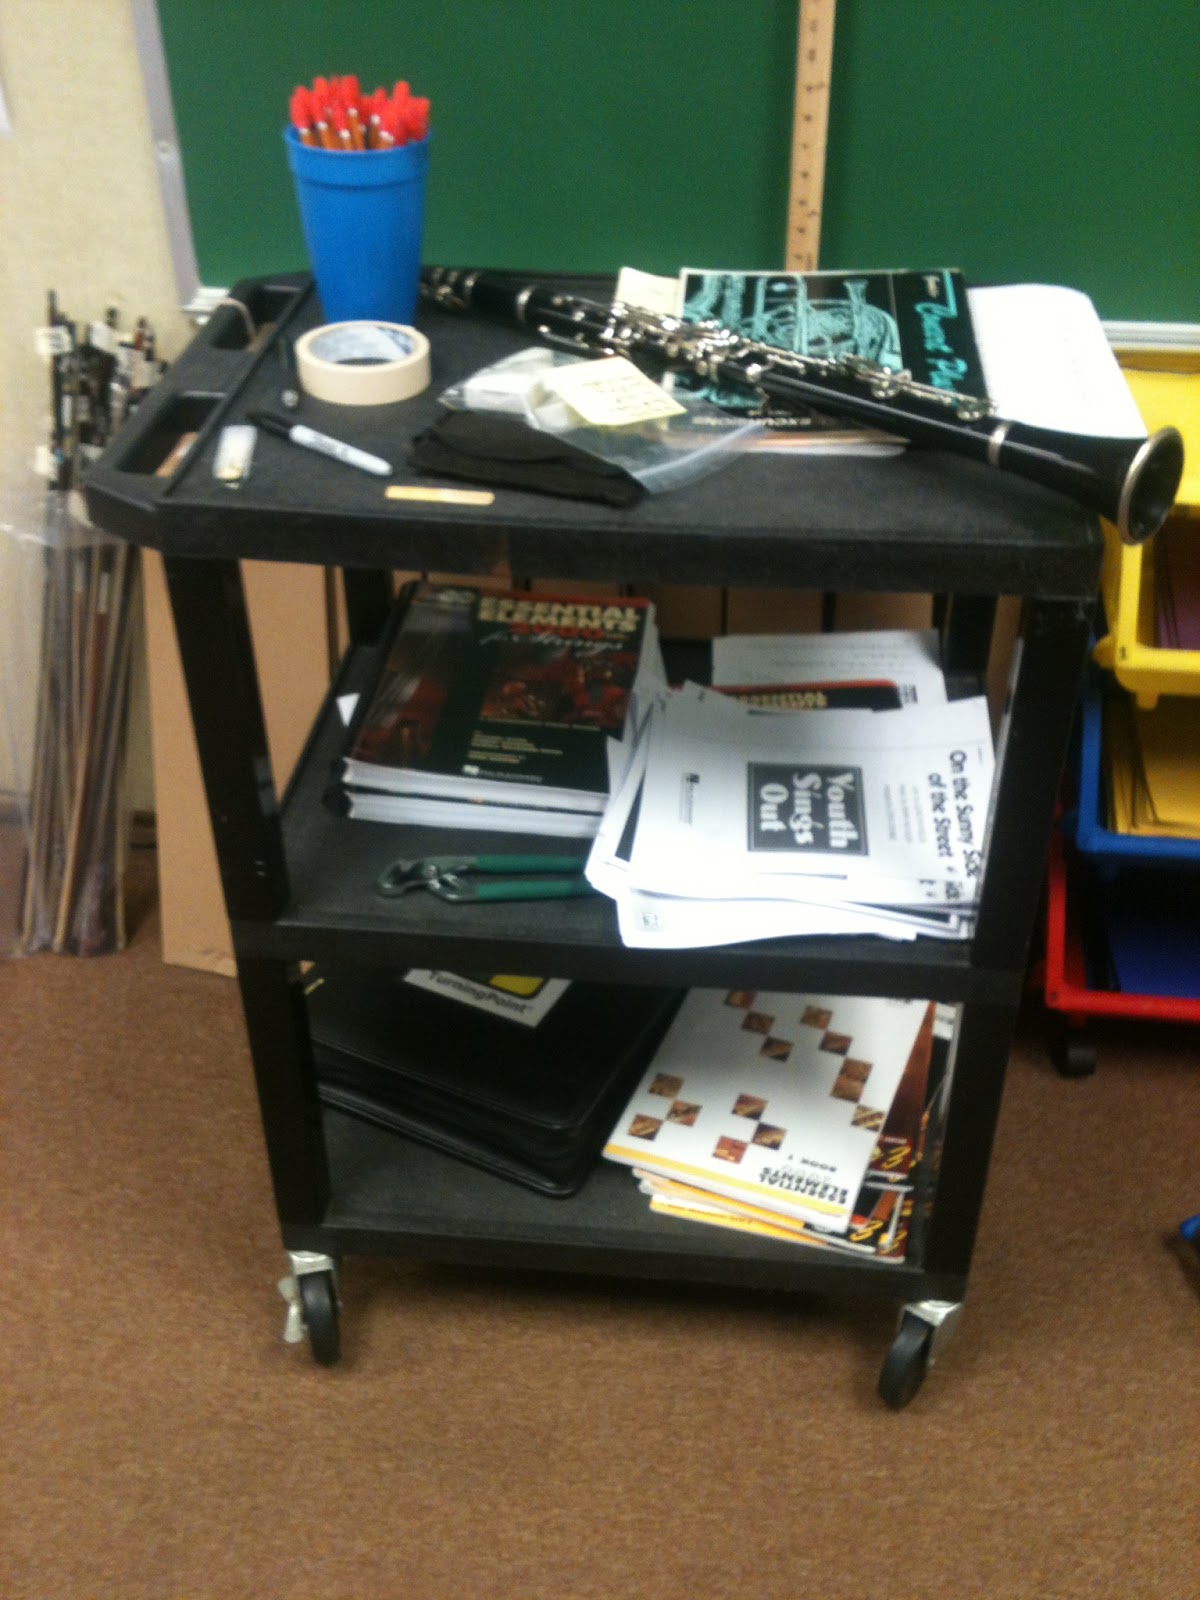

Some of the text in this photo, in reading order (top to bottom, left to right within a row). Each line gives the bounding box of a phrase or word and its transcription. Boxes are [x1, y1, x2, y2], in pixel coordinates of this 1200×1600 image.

[759, 782, 790, 832] Out
[788, 772, 825, 845] Sings
[827, 772, 860, 848] Youth
[928, 773, 953, 858] of the Street
[950, 750, 983, 878] On the Sunny Side
